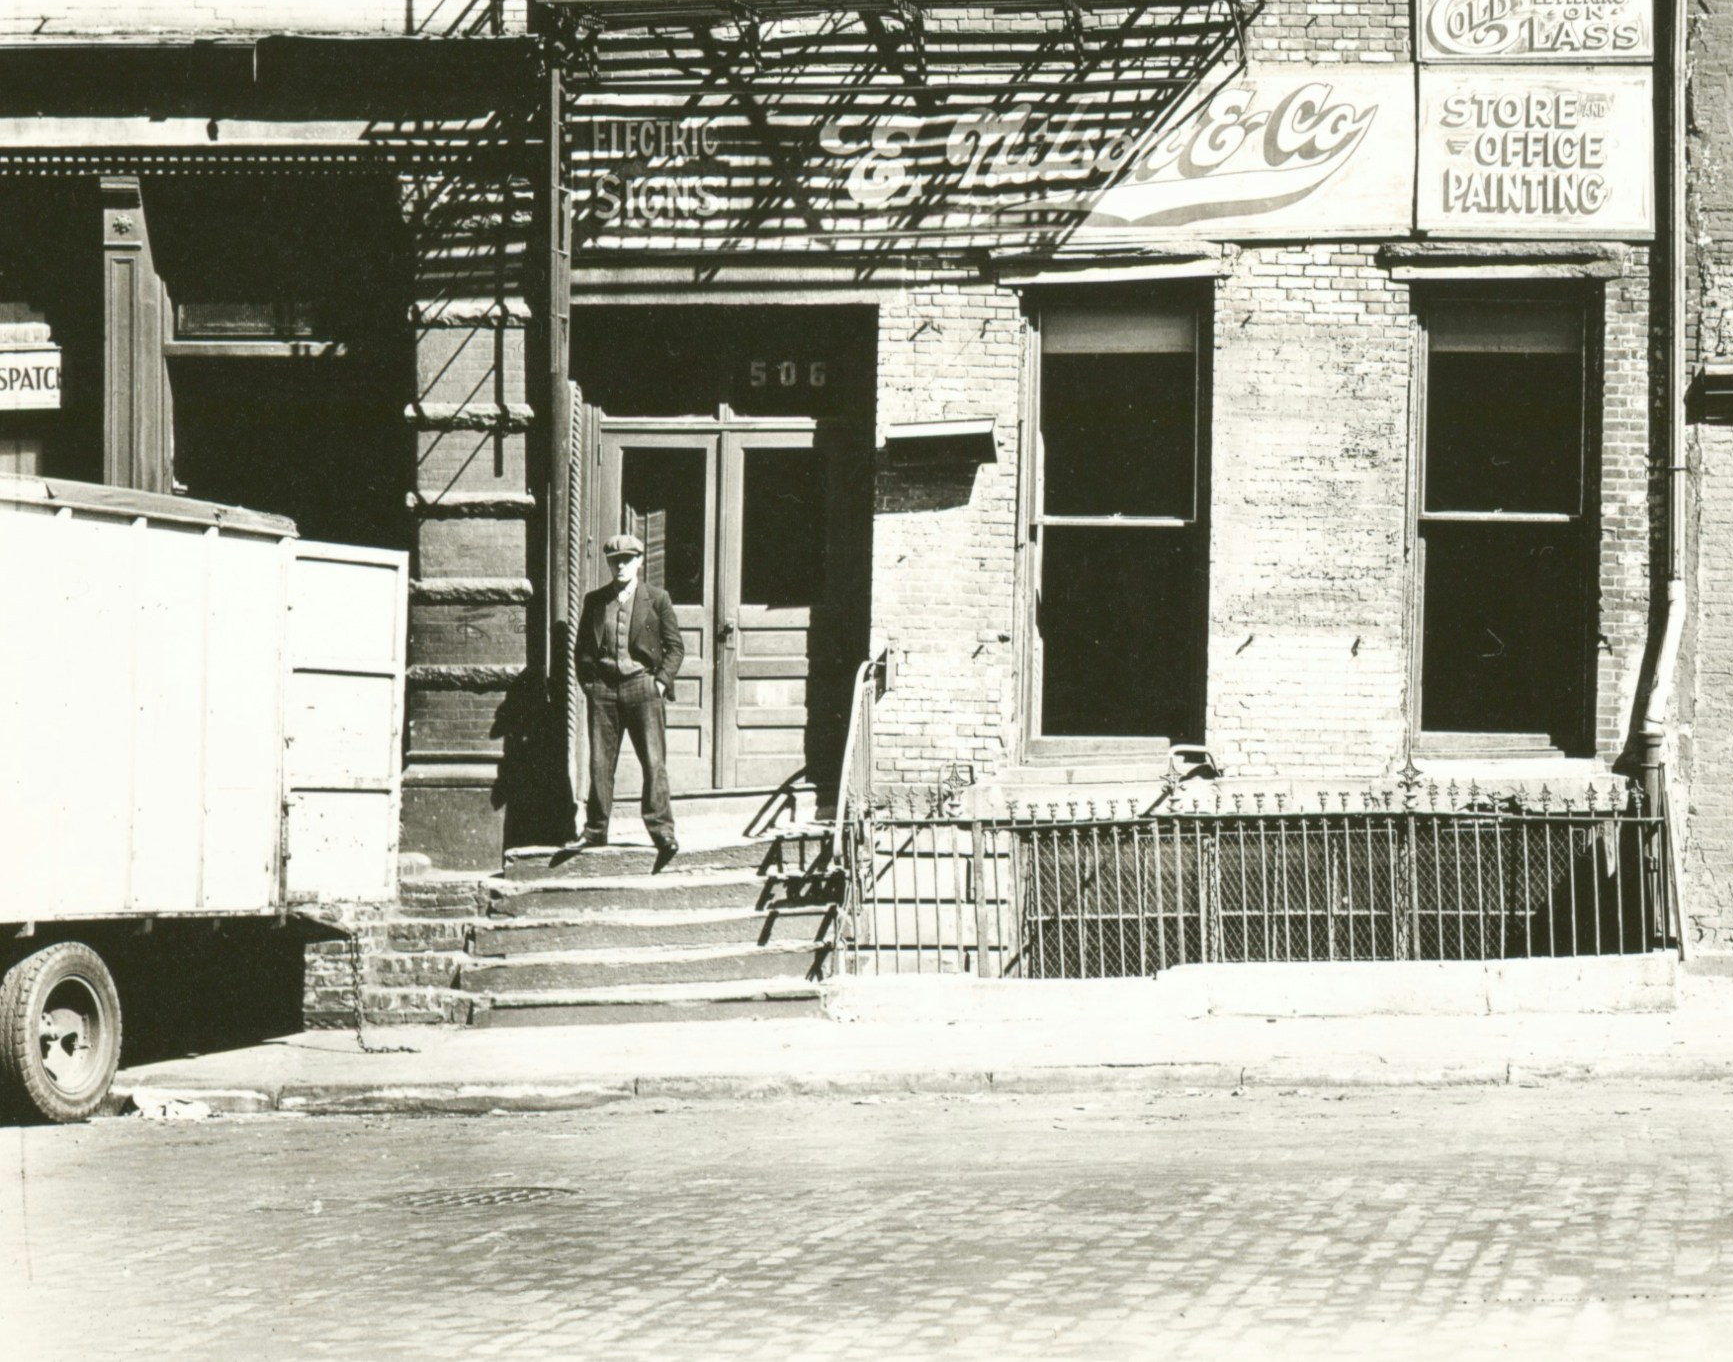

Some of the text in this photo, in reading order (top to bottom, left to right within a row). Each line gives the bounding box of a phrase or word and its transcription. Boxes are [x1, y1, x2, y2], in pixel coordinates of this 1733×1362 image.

[1562, 5, 1604, 21] ON
[1440, 93, 1608, 129] STORE AND
[593, 121, 719, 158] ELECTRIC
[1475, 131, 1605, 168] OFFICE
[594, 174, 719, 220] SIGNS
[1442, 168, 1608, 215] PAINTING
[750, 360, 827, 388] 506
